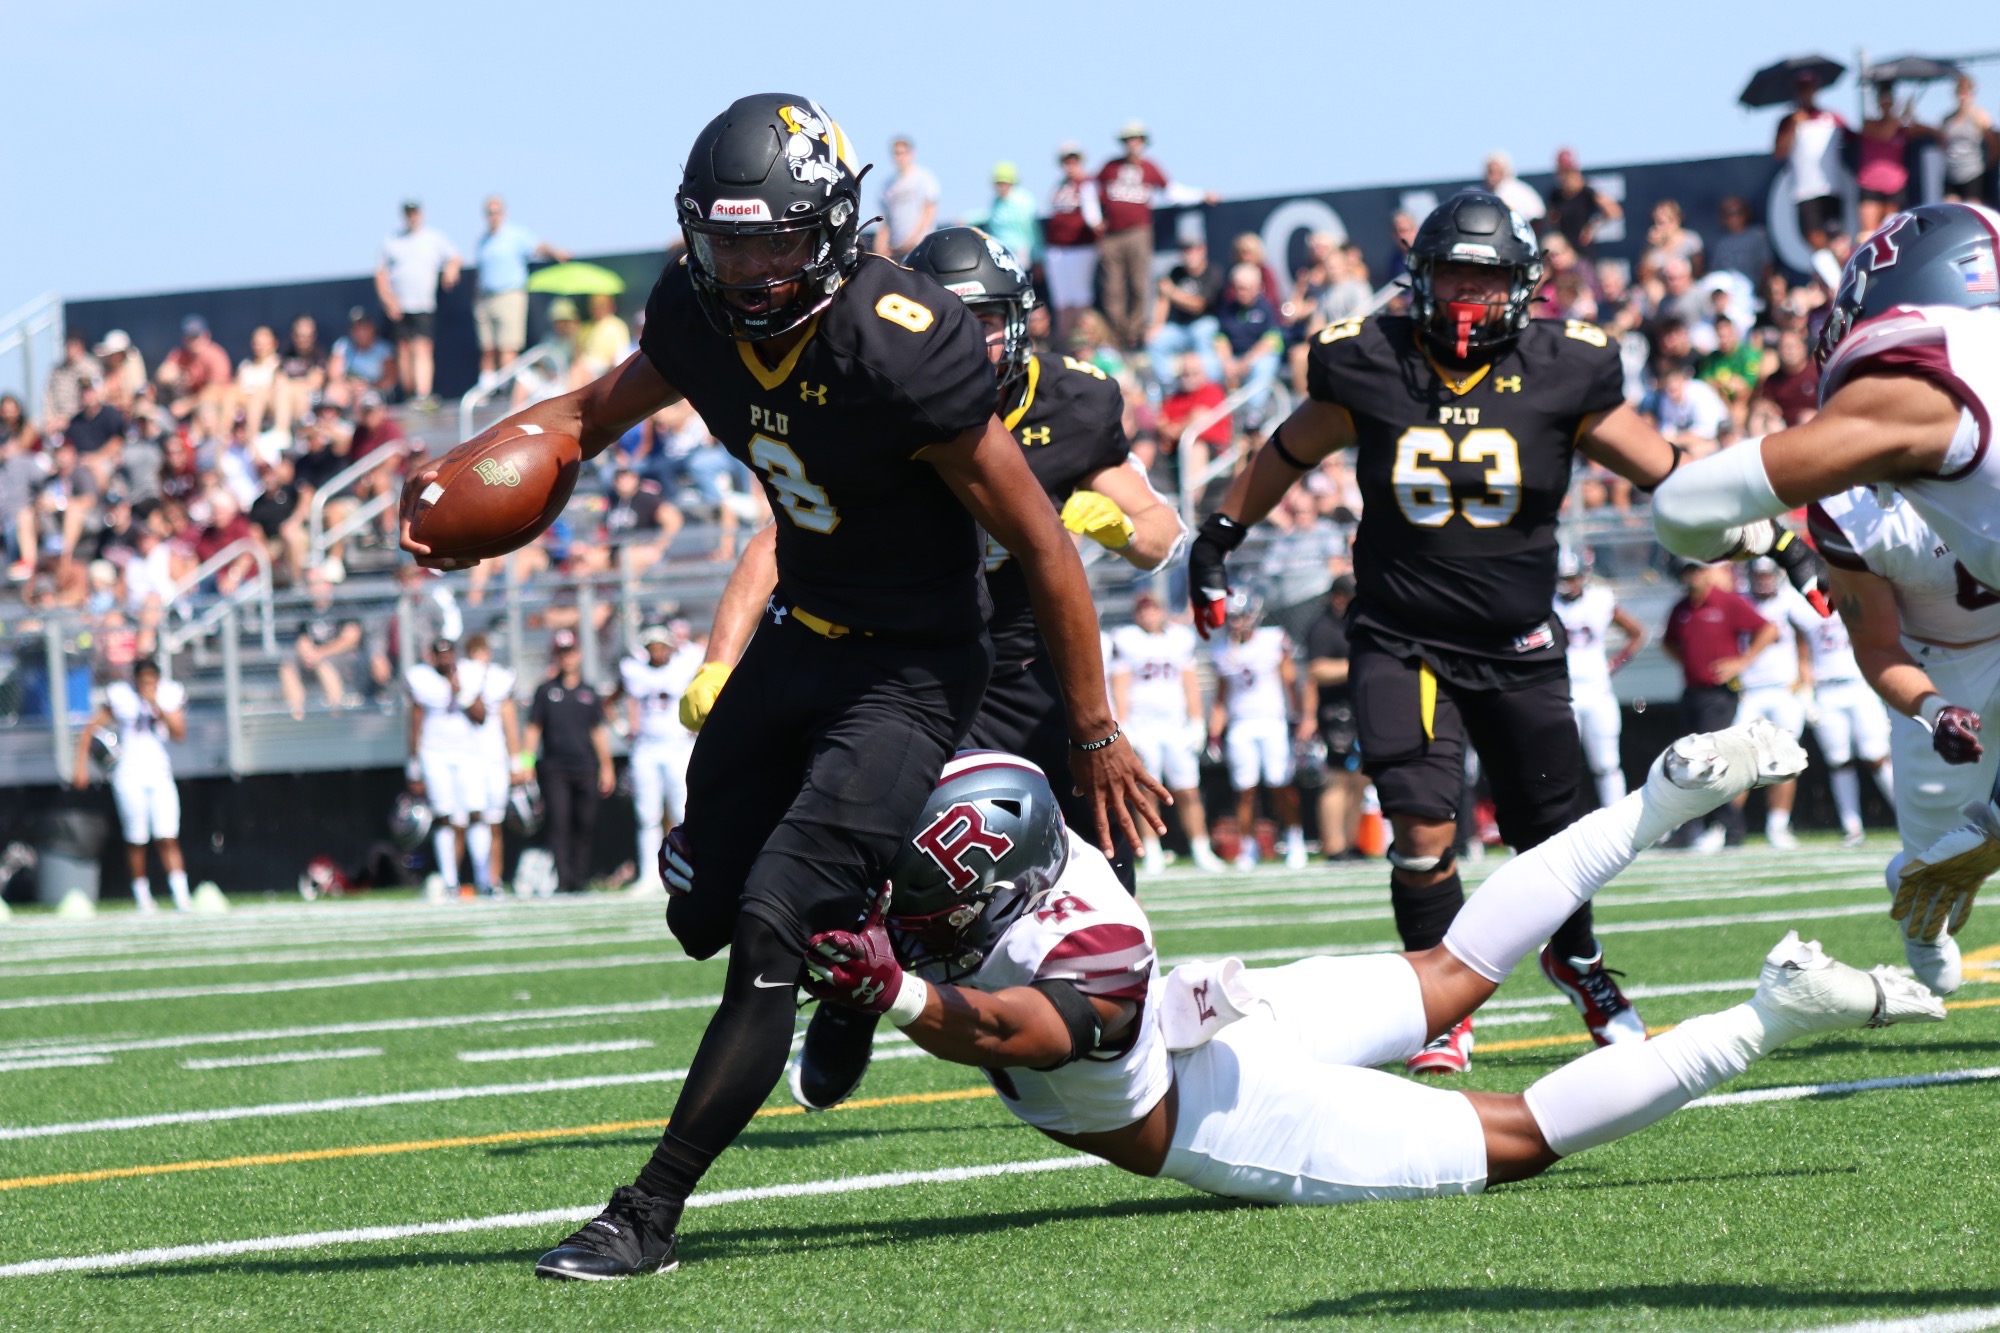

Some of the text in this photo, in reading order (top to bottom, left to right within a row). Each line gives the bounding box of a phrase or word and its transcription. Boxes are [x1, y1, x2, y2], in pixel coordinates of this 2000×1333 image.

[716, 204, 761, 216] Riddell
[875, 293, 934, 333] 8
[750, 404, 789, 436] PLU
[1439, 406, 1480, 426] PLU
[747, 432, 842, 535] 8
[1391, 426, 1522, 528] 63
[1081, 739, 1107, 750] AKUA
[912, 801, 1015, 894] R
